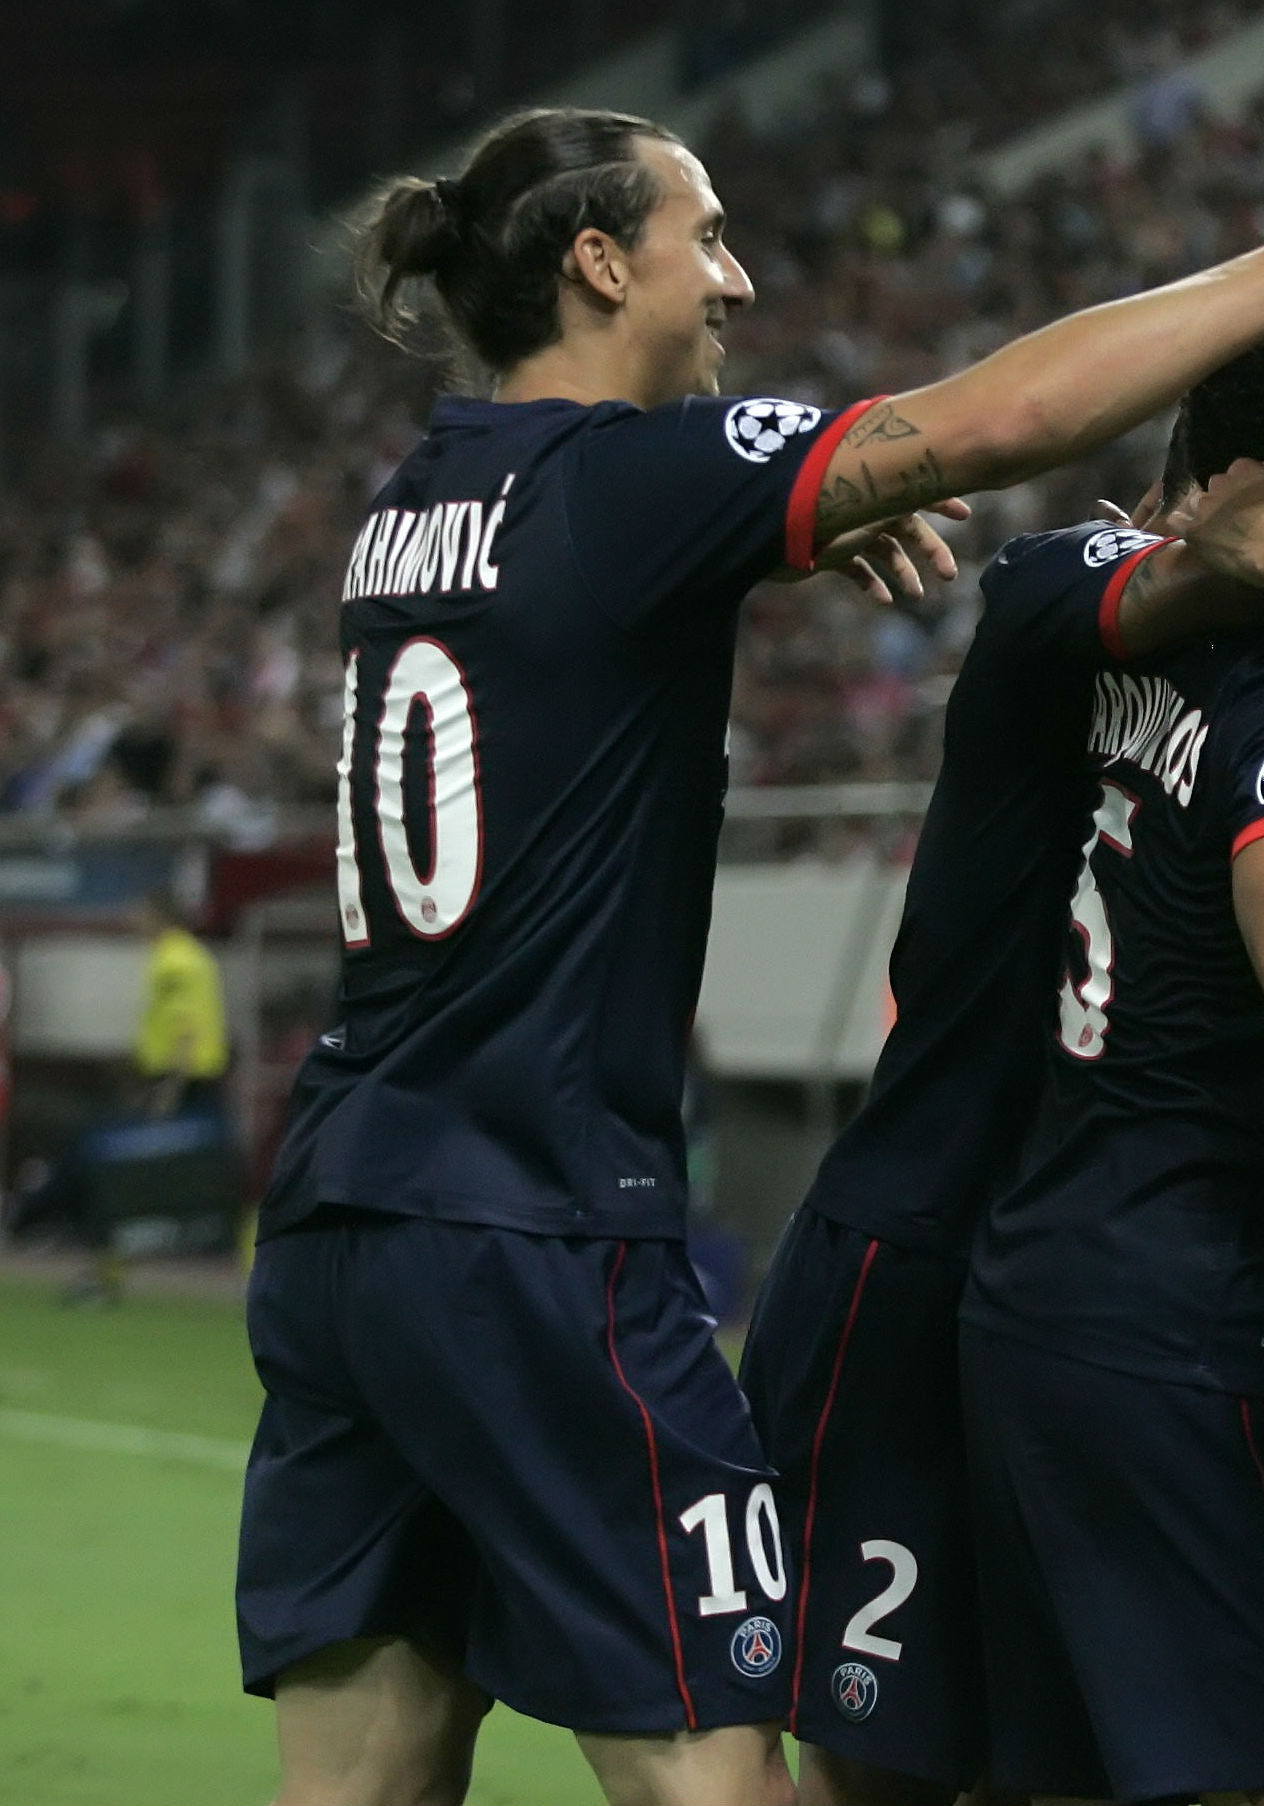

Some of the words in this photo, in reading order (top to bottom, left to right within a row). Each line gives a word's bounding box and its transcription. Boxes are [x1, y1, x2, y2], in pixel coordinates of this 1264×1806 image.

[678, 1482, 787, 1617] 10
[842, 1539, 919, 1662] 2
[839, 1666, 873, 1685] PARIS
